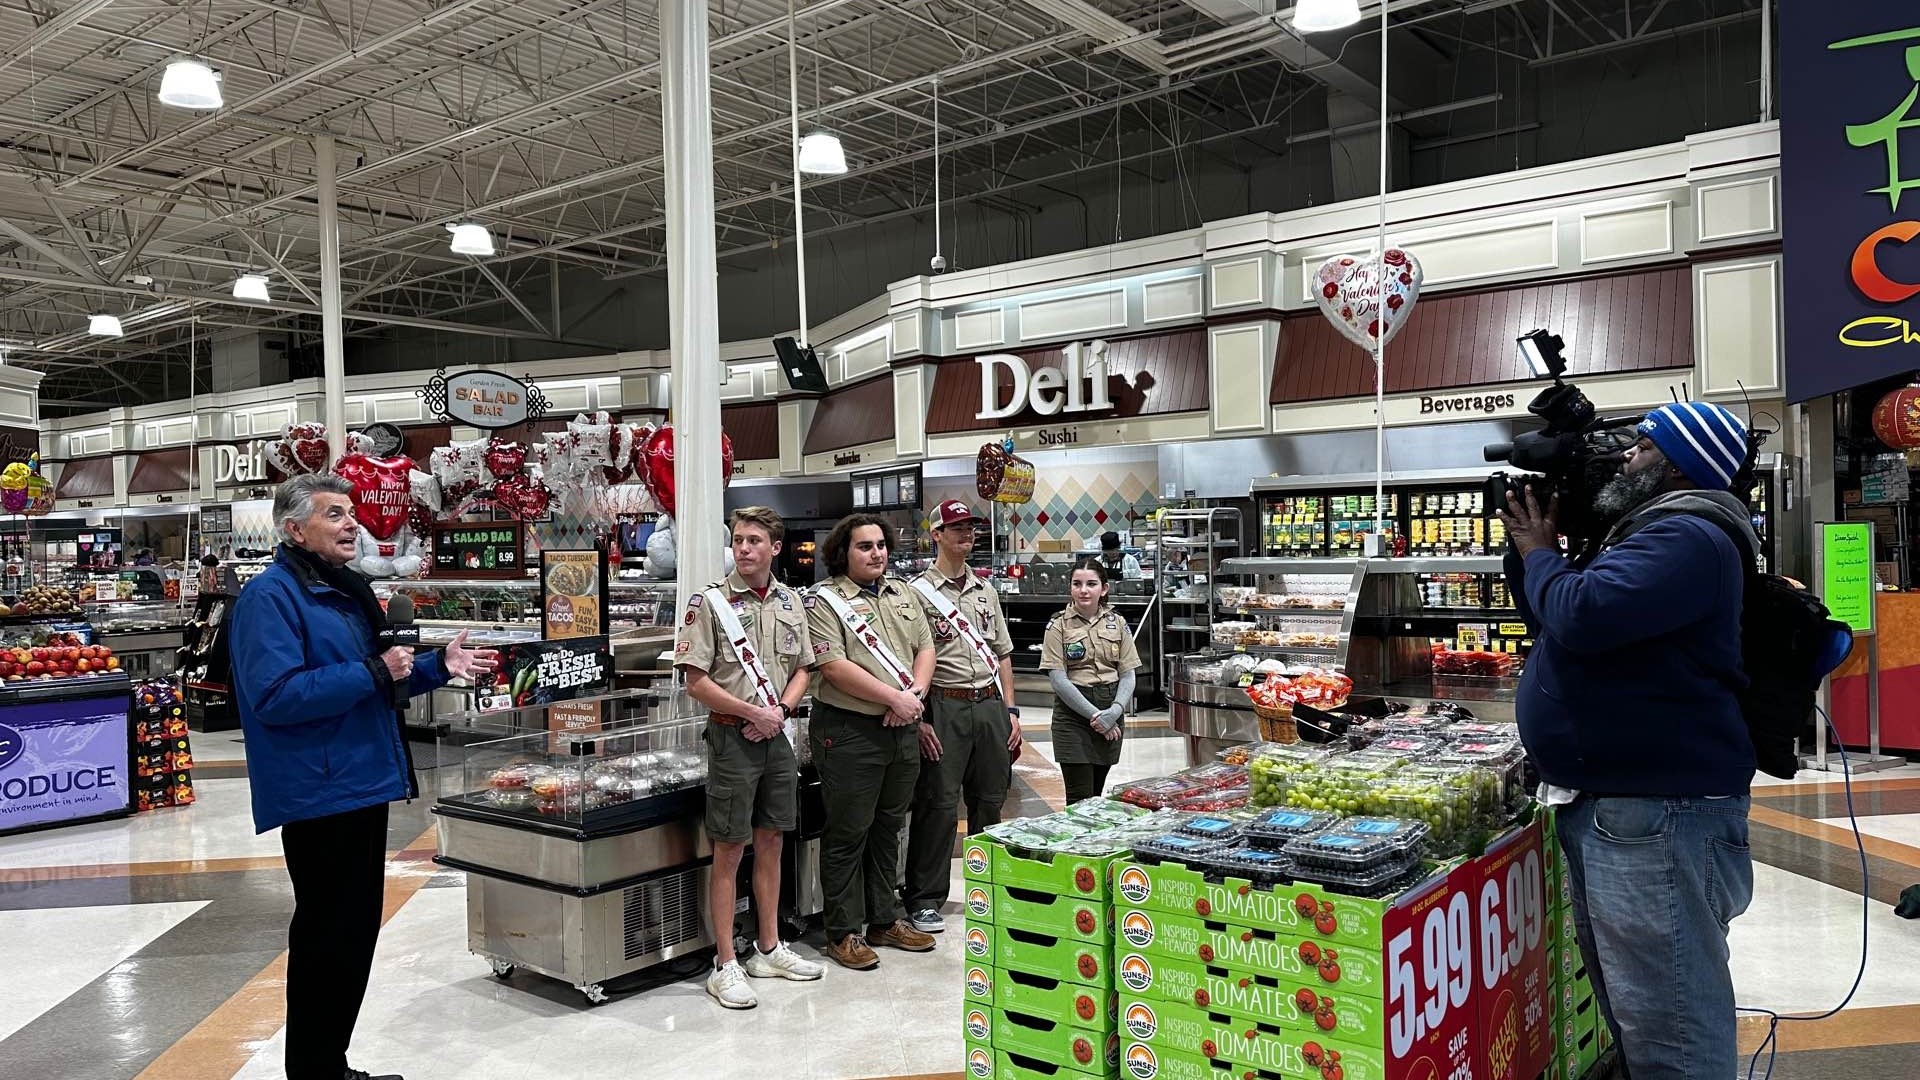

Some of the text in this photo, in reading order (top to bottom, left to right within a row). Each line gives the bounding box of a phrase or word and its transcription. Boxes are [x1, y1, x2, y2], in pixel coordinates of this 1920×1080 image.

[1346, 265, 1389, 283] Hapy
[975, 339, 1115, 420] Deli
[455, 387, 519, 405] SALAD
[1420, 393, 1514, 414] Beverages
[473, 404, 503, 416] BAR
[1038, 426, 1078, 445] Sushi
[215, 440, 267, 482] Deli
[381, 481, 404, 490] HAPPY
[382, 505, 402, 516] DAY!
[453, 531, 513, 543] SALAD BAR
[498, 551, 514, 562] 8.99
[549, 554, 593, 562] TACO TUESDAY
[547, 612, 574, 622] TACOS
[575, 615, 593, 625] EASY
[576, 624, 596, 635] TASTY
[541, 649, 574, 662] We Do
[537, 653, 597, 679] FRESH
[538, 665, 604, 689] The BEST
[554, 713, 568, 721] FAST
[572, 714, 596, 722] FRIENDLY
[565, 720, 586, 729] SERVICE
[0, 766, 116, 800] ODUCE
[62, 797, 72, 806] in
[1120, 884, 1150, 896] SUNSET
[1158, 879, 1196, 896] INSPIRED
[1161, 892, 1194, 910] FLAVOR
[1205, 886, 1297, 926] TOMATOES
[1479, 849, 1541, 990] 6.99
[1123, 928, 1153, 940] SUNSET
[1161, 923, 1199, 942] INSPIRED
[1164, 938, 1197, 956] FLAVOR
[1208, 932, 1301, 973] TOMATOES
[1121, 971, 1152, 984] SUNSET
[1159, 967, 1197, 987] INSPIRED
[1388, 890, 1472, 1059] 5.99
[1524, 967, 1539, 994] SAVE
[967, 981, 988, 990] SUNSET
[1161, 983, 1194, 1000] FLAVOR
[1205, 977, 1298, 1021] TOMATES
[967, 1023, 988, 1033] SUNSET
[1126, 1020, 1156, 1033] SUNSET
[1164, 1016, 1202, 1037] INSPIRED
[1489, 1002, 1517, 1066] VALUE
[1212, 1027, 1304, 1073] TOMATOES
[1448, 1026, 1468, 1059] SAVE
[1459, 1050, 1466, 1059] TO
[1493, 1024, 1519, 1080] PACK
[1127, 1060, 1156, 1073] SUNSET
[1164, 1058, 1202, 1077] INSPIRED
